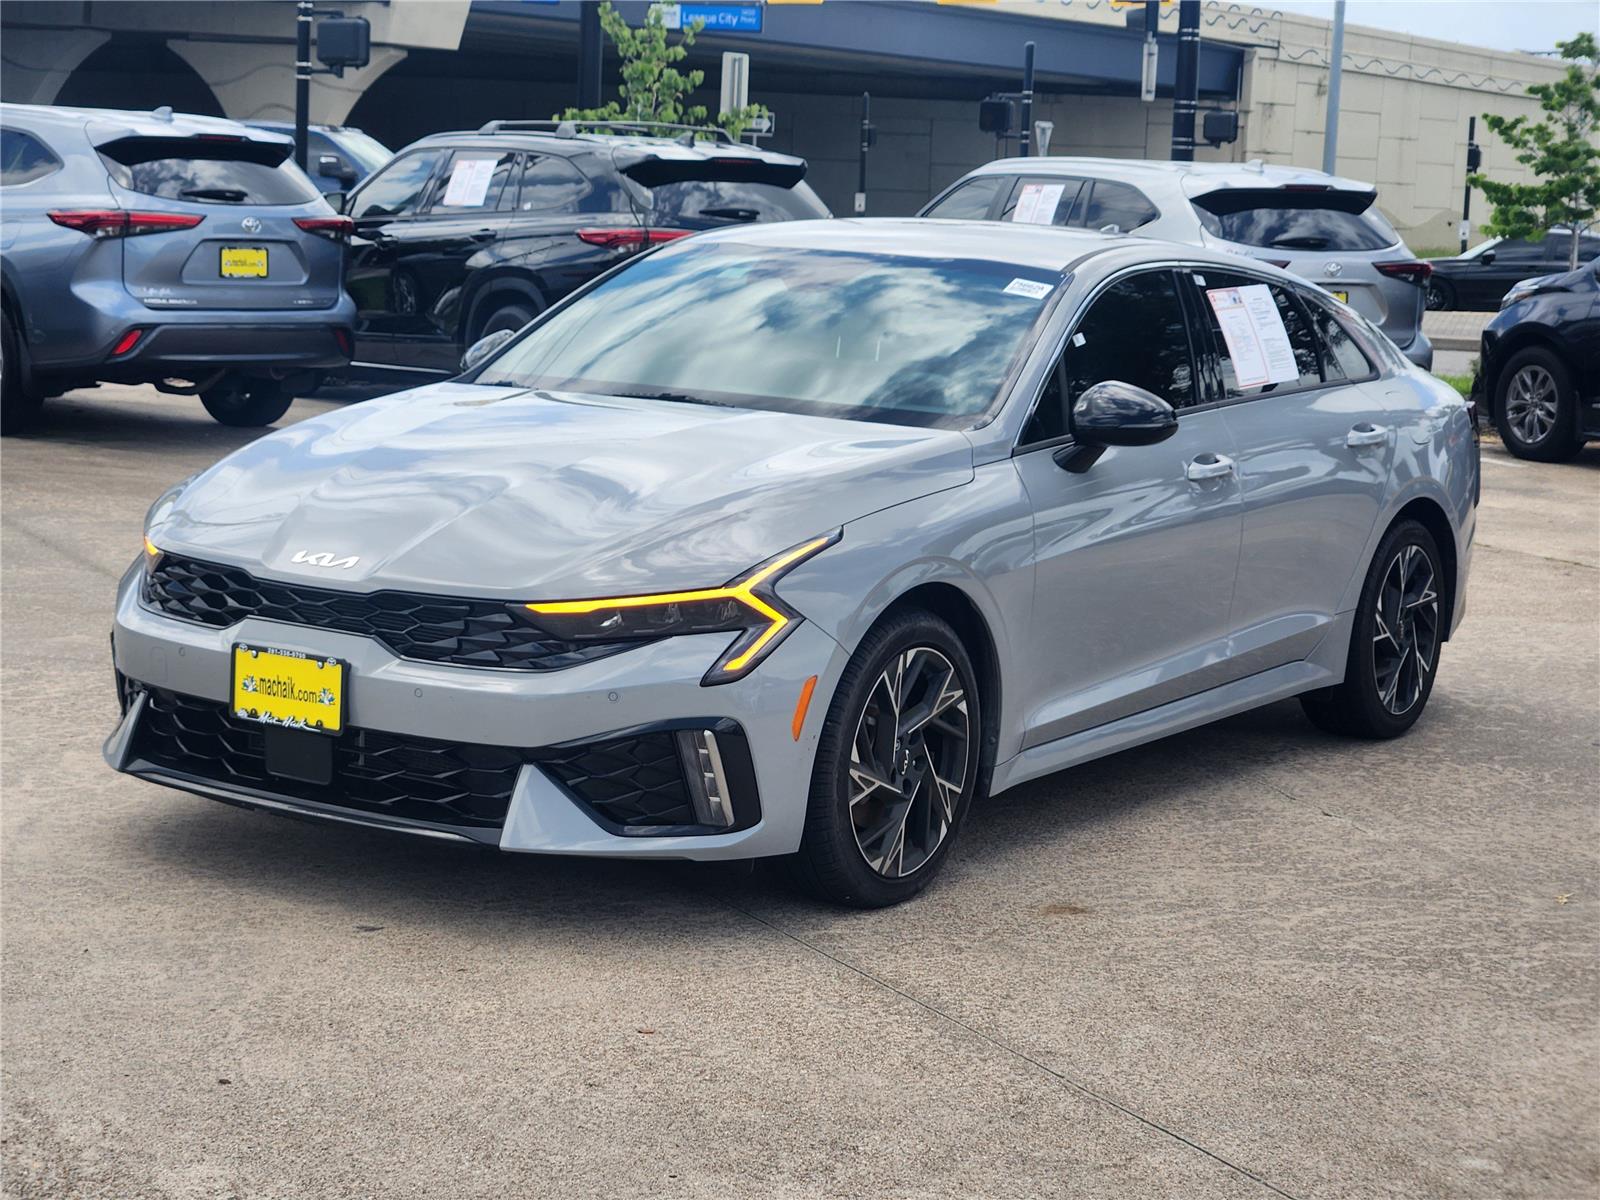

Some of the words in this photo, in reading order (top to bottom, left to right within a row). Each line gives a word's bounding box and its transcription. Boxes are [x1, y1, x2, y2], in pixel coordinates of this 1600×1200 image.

[682, 12, 717, 25] Leue
[718, 11, 738, 26] City
[291, 550, 360, 569] KIA
[259, 676, 318, 703] machaik.com
